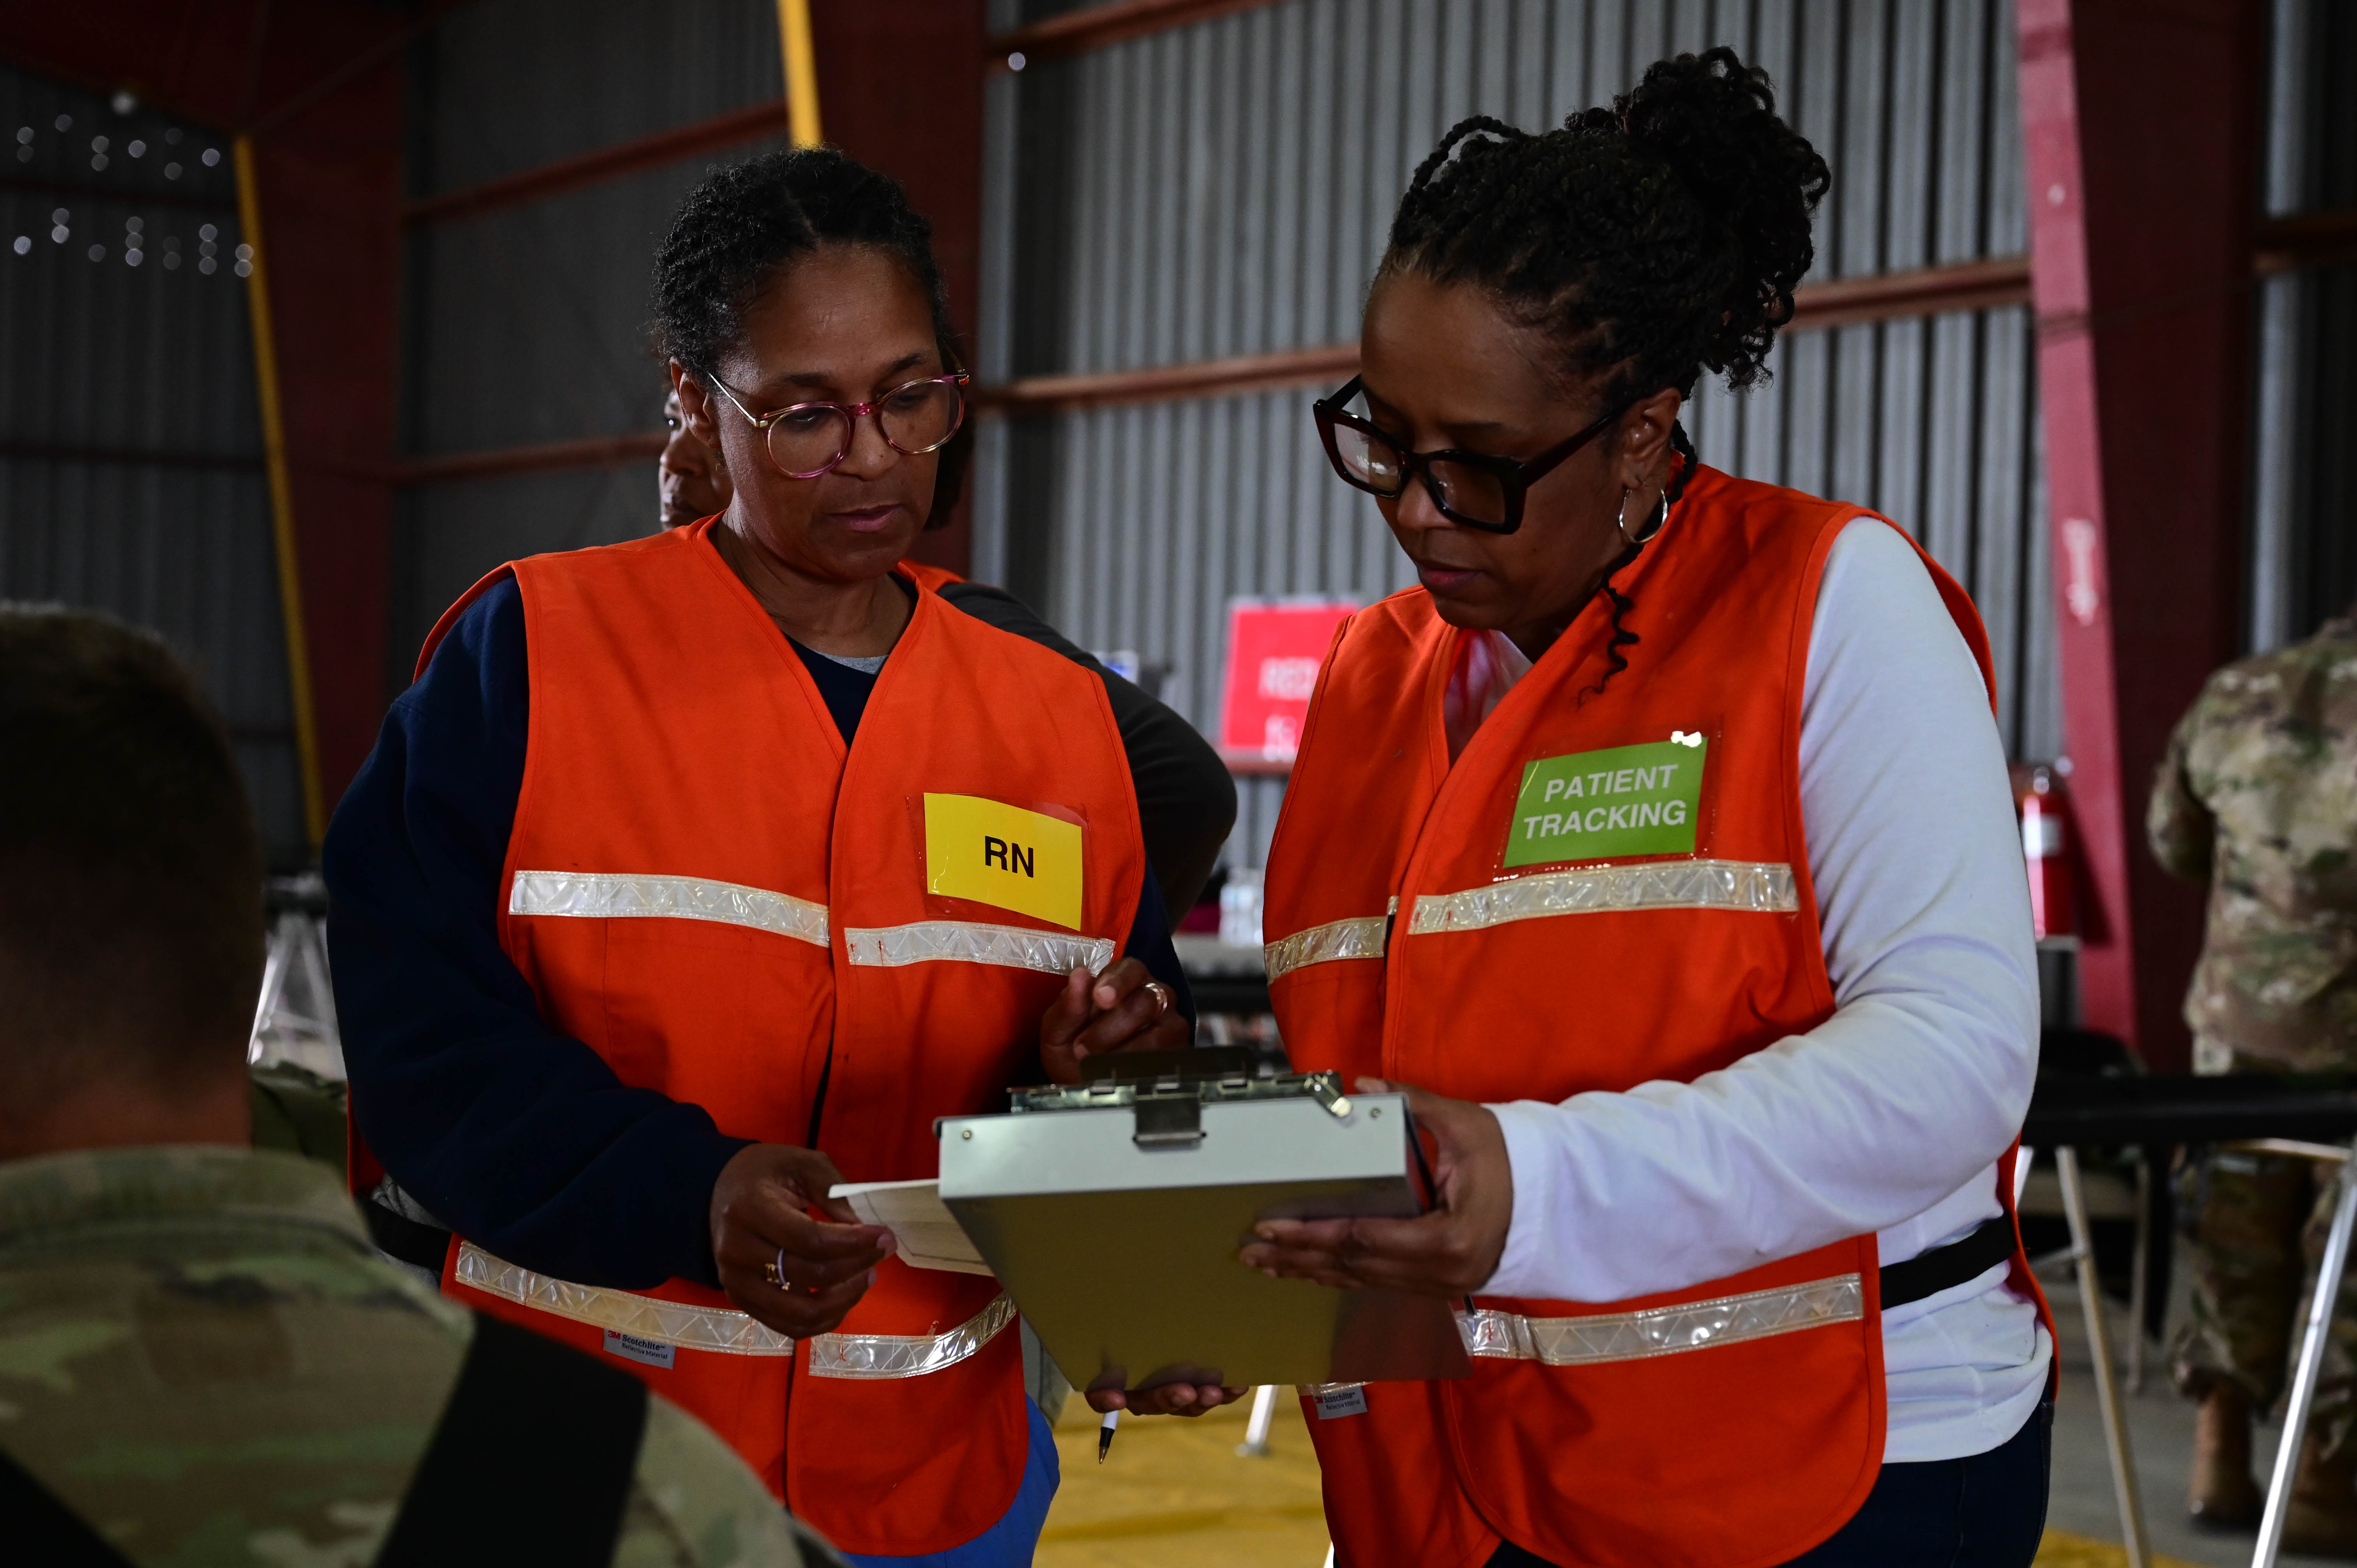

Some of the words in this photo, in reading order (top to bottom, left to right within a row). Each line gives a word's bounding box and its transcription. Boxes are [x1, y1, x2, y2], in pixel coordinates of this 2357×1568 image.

[1544, 764, 1679, 803] PATIENT
[1523, 800, 1687, 839] TRACKING
[984, 835, 1034, 878] RN
[608, 1330, 620, 1340] 3M
[622, 1343, 645, 1354] Reflective
[646, 1351, 667, 1359] Material
